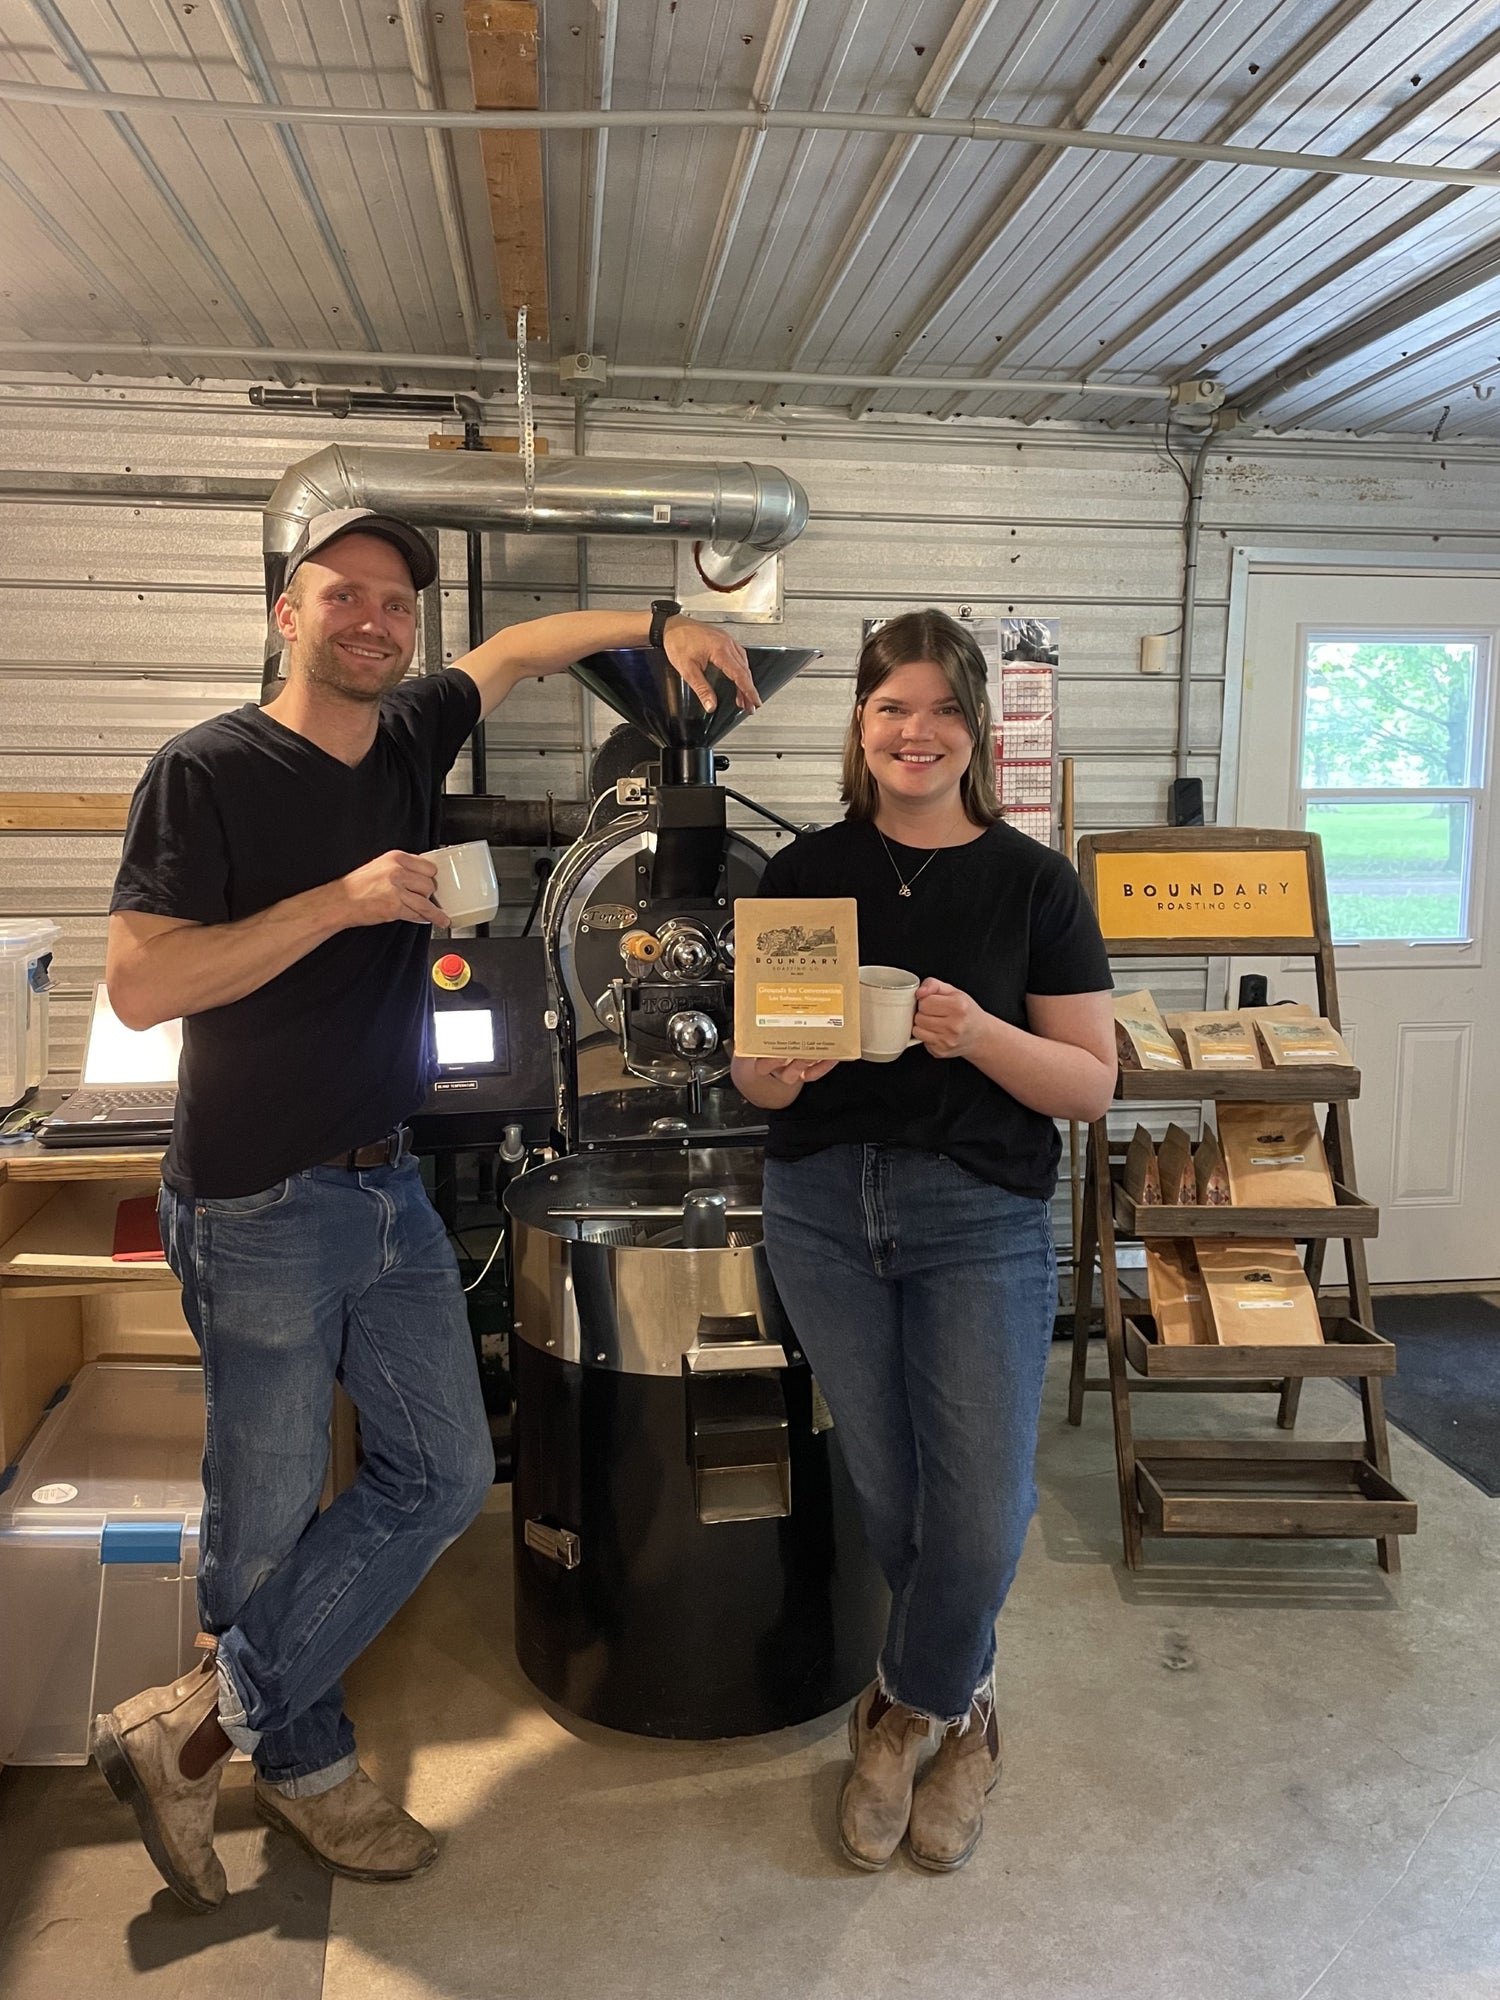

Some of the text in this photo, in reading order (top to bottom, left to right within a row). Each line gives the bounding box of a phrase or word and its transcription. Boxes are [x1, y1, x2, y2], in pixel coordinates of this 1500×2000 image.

[1123, 882, 1289, 898] BOUNDARY
[1157, 902, 1226, 911] ROASTING
[755, 957, 838, 965] BOUNDARY
